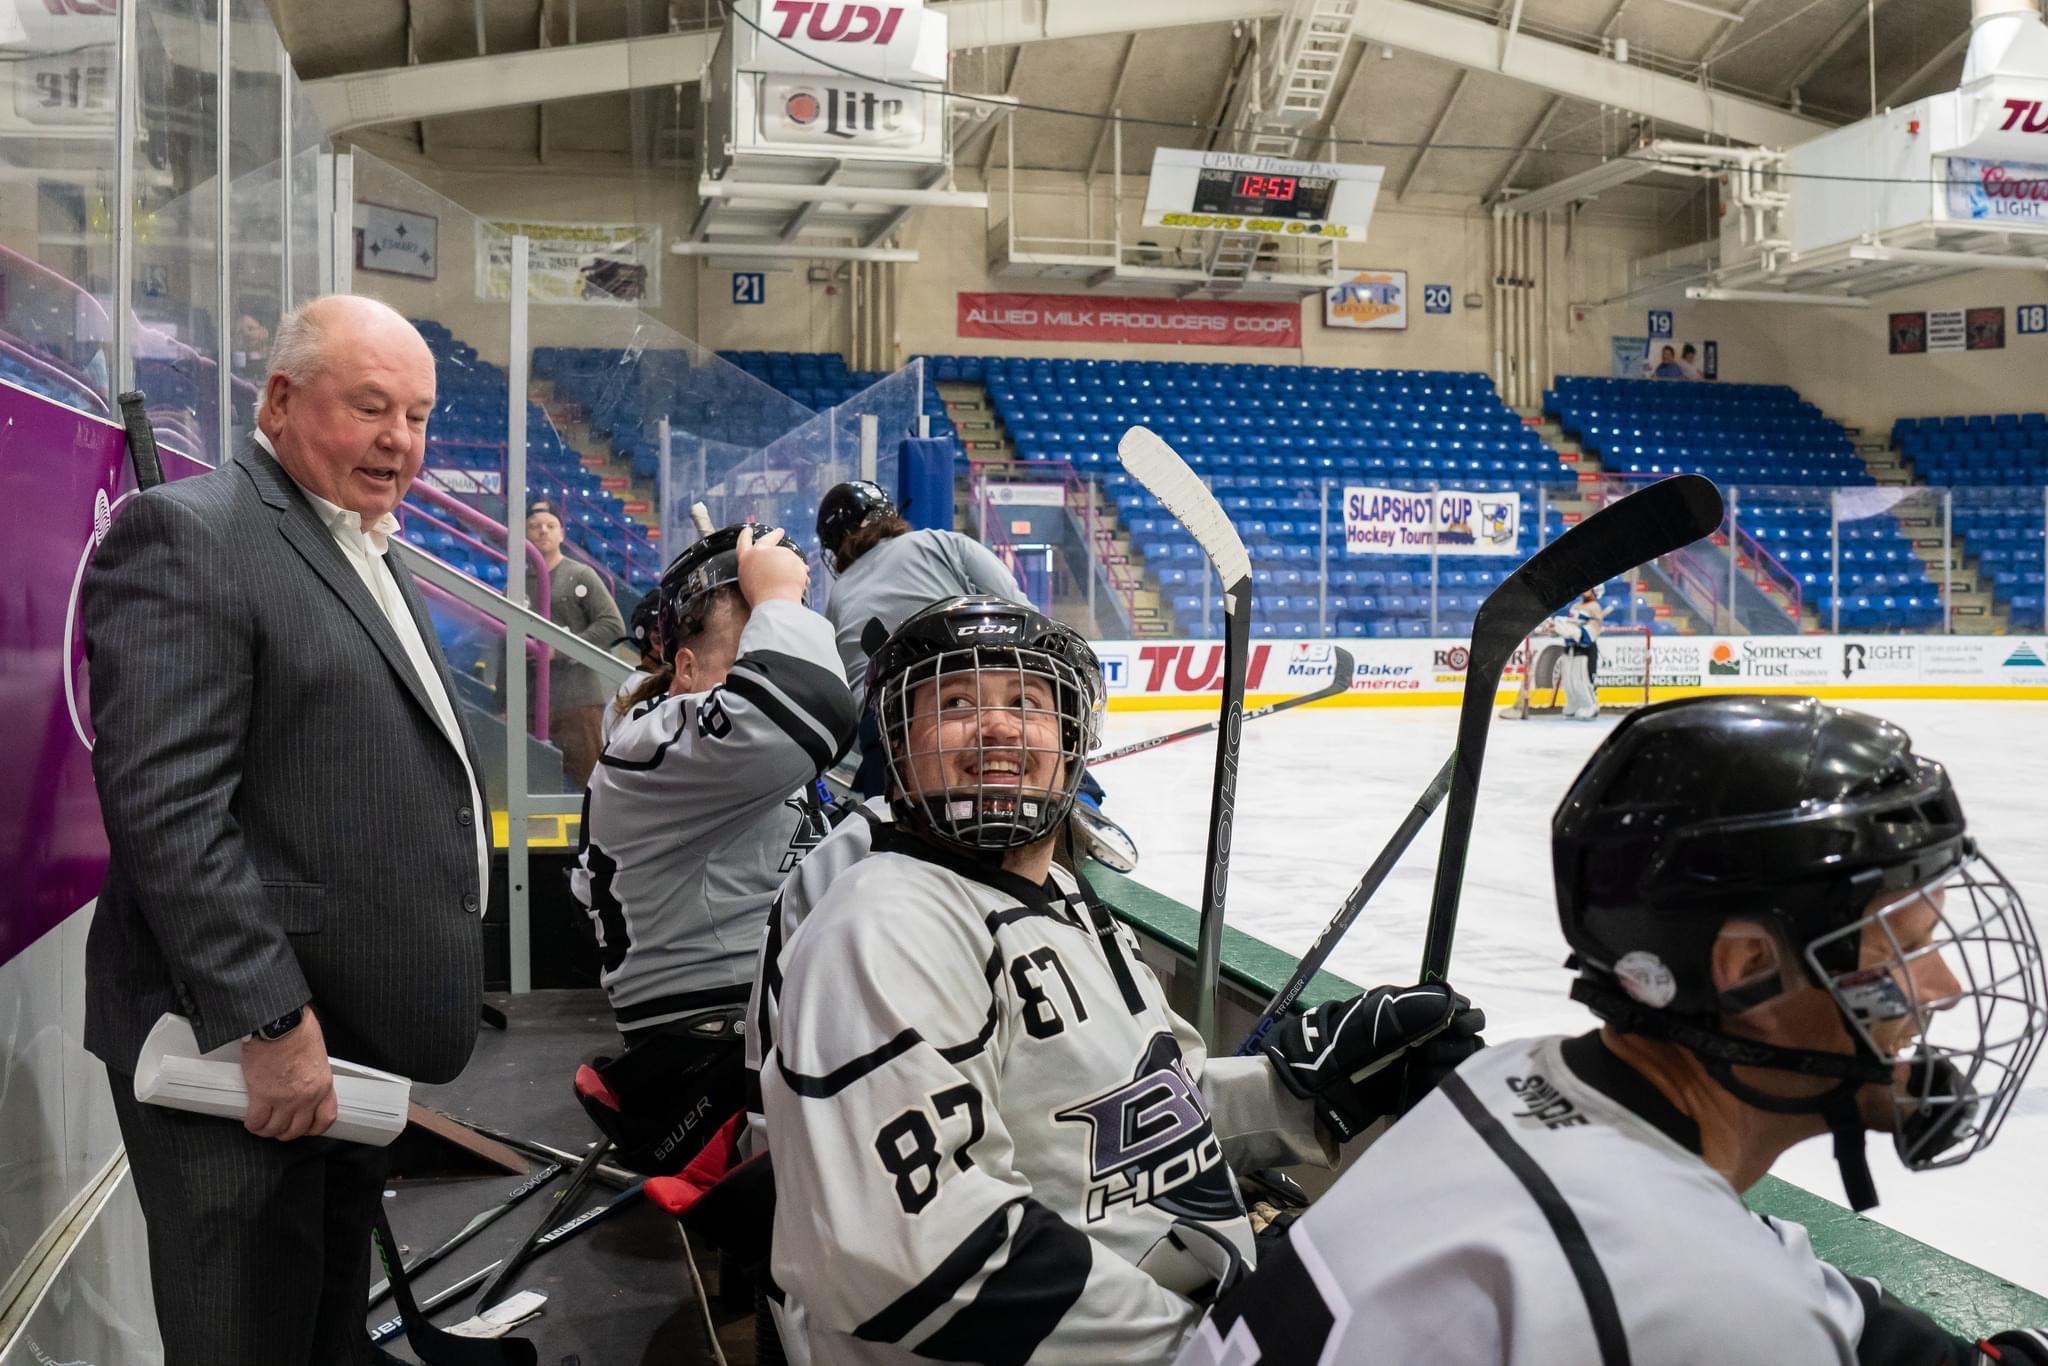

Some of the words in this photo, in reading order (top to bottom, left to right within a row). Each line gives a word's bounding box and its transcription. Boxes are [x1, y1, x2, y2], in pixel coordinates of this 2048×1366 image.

[773, 1, 904, 45] TUDI
[824, 88, 904, 139] Lite
[2000, 98, 2048, 133] TU
[1201, 154, 1248, 169] UPMC
[1240, 175, 1297, 199] 12:53
[1995, 199, 2040, 216] LIGHT
[1160, 213, 1243, 229] SHOTS
[1246, 217, 1284, 232] ON
[735, 274, 760, 301] 21
[1425, 289, 1451, 308] 20
[966, 307, 1038, 326] ALLIED
[1045, 310, 1094, 327] MILK
[1650, 315, 1671, 332] 19
[2020, 307, 2045, 332] 18
[1349, 494, 1436, 524] SLAPSHOT
[1440, 498, 1473, 524] CUP
[1347, 525, 1395, 547] Hockey
[957, 625, 1018, 637] CCM
[1742, 640, 1823, 659] Somerset
[1138, 645, 1272, 692] TUI
[1288, 664, 1334, 676] Mart
[1357, 664, 1413, 676] Baker
[1743, 657, 1790, 676] Trust
[1349, 678, 1420, 689] merica
[1212, 700, 1244, 908] COHO
[654, 1096, 713, 1161] BAUER
[873, 1082, 987, 1216] 87
[1086, 1132, 1222, 1224] HOC
